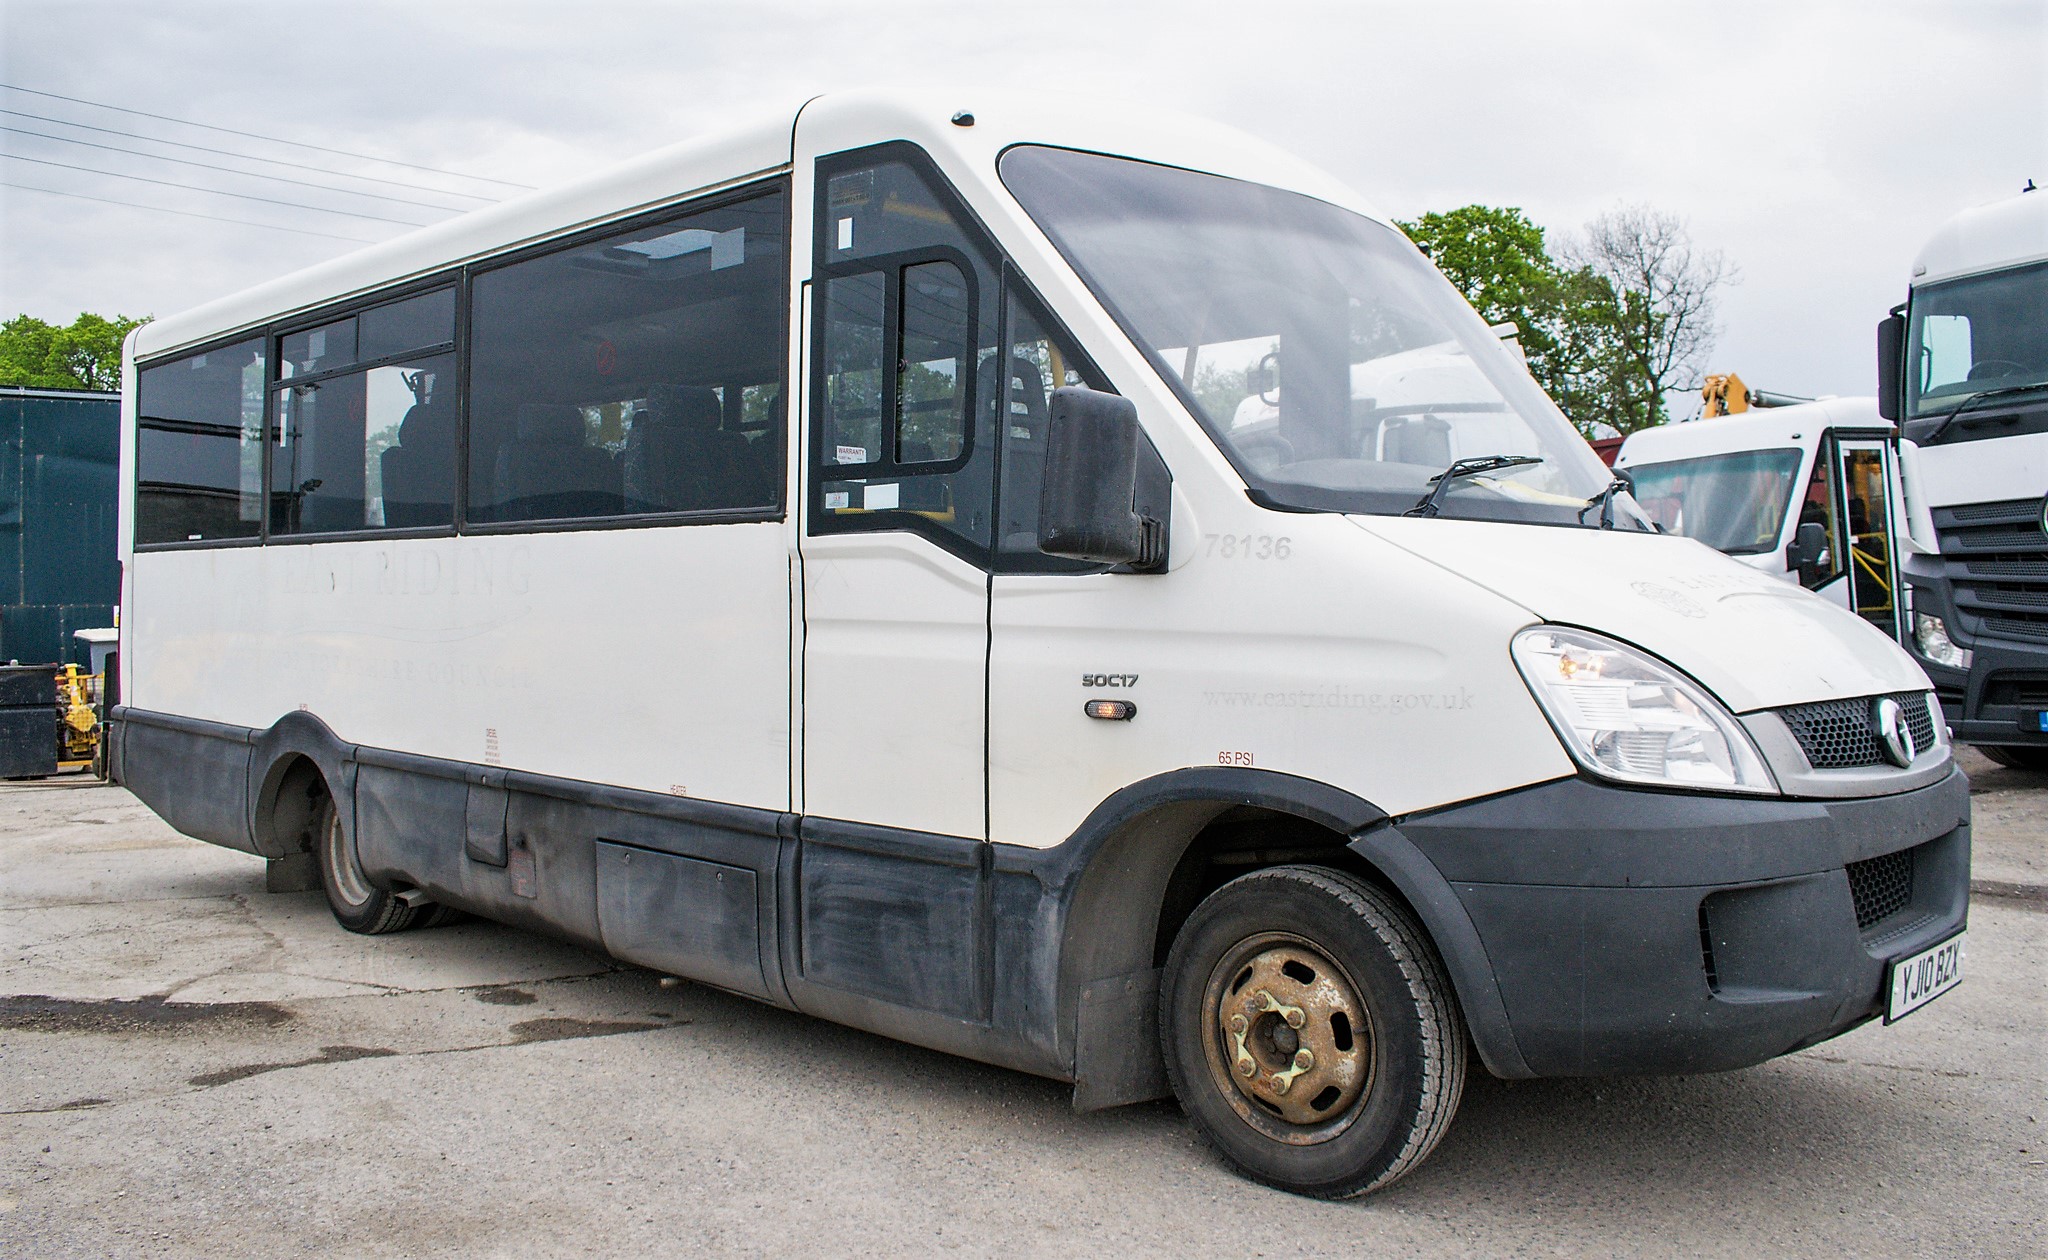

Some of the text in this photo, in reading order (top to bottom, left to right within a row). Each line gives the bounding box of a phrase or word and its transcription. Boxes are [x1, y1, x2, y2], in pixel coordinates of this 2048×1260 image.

[838, 447, 865, 456] WARRANTY
[1204, 533, 1292, 560] 78136
[376, 544, 533, 596] RIDING
[1082, 673, 1139, 688] 50C17
[1203, 685, 1475, 715] www.eastriding.gov.uk
[1218, 751, 1254, 766] 65 PSI
[1903, 940, 1961, 1004] YJ10 BZX
